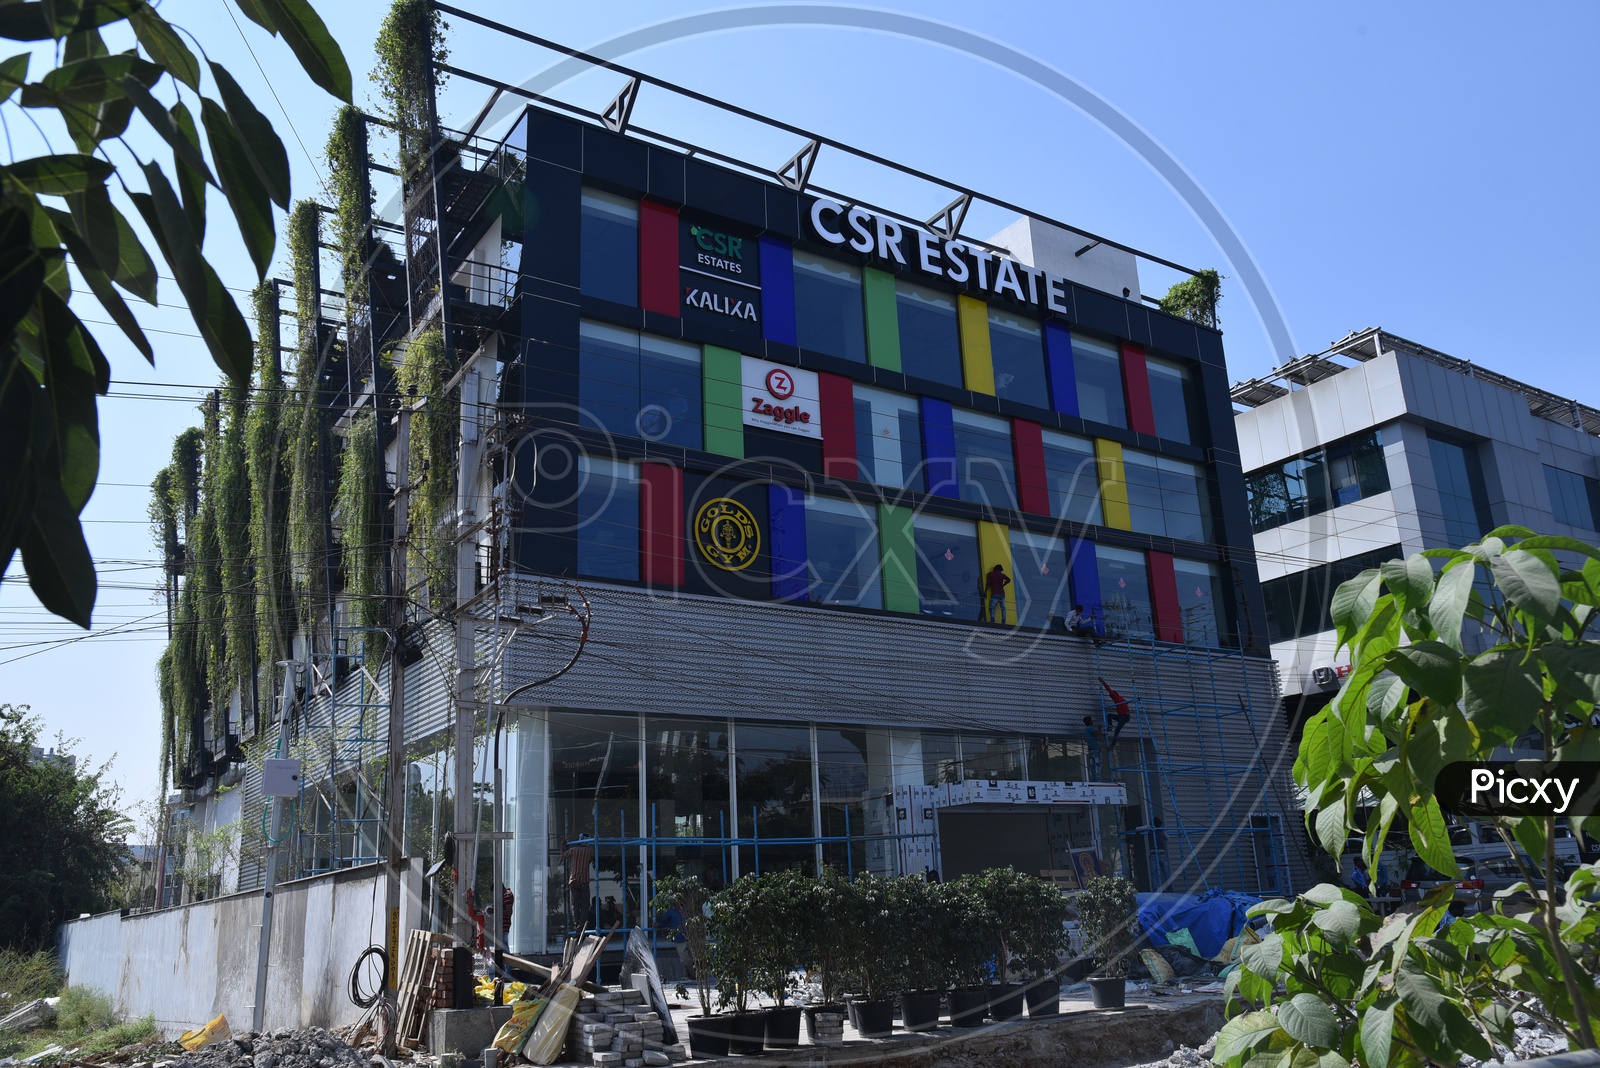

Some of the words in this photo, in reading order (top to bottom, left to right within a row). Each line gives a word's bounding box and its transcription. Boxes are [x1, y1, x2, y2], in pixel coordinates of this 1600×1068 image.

[696, 228, 743, 260] CSR
[810, 198, 907, 265] CSR
[917, 230, 1067, 314] ESTATE
[697, 253, 742, 274] ESTATES
[686, 287, 757, 322] KALIKA
[752, 397, 811, 424] Zaggle
